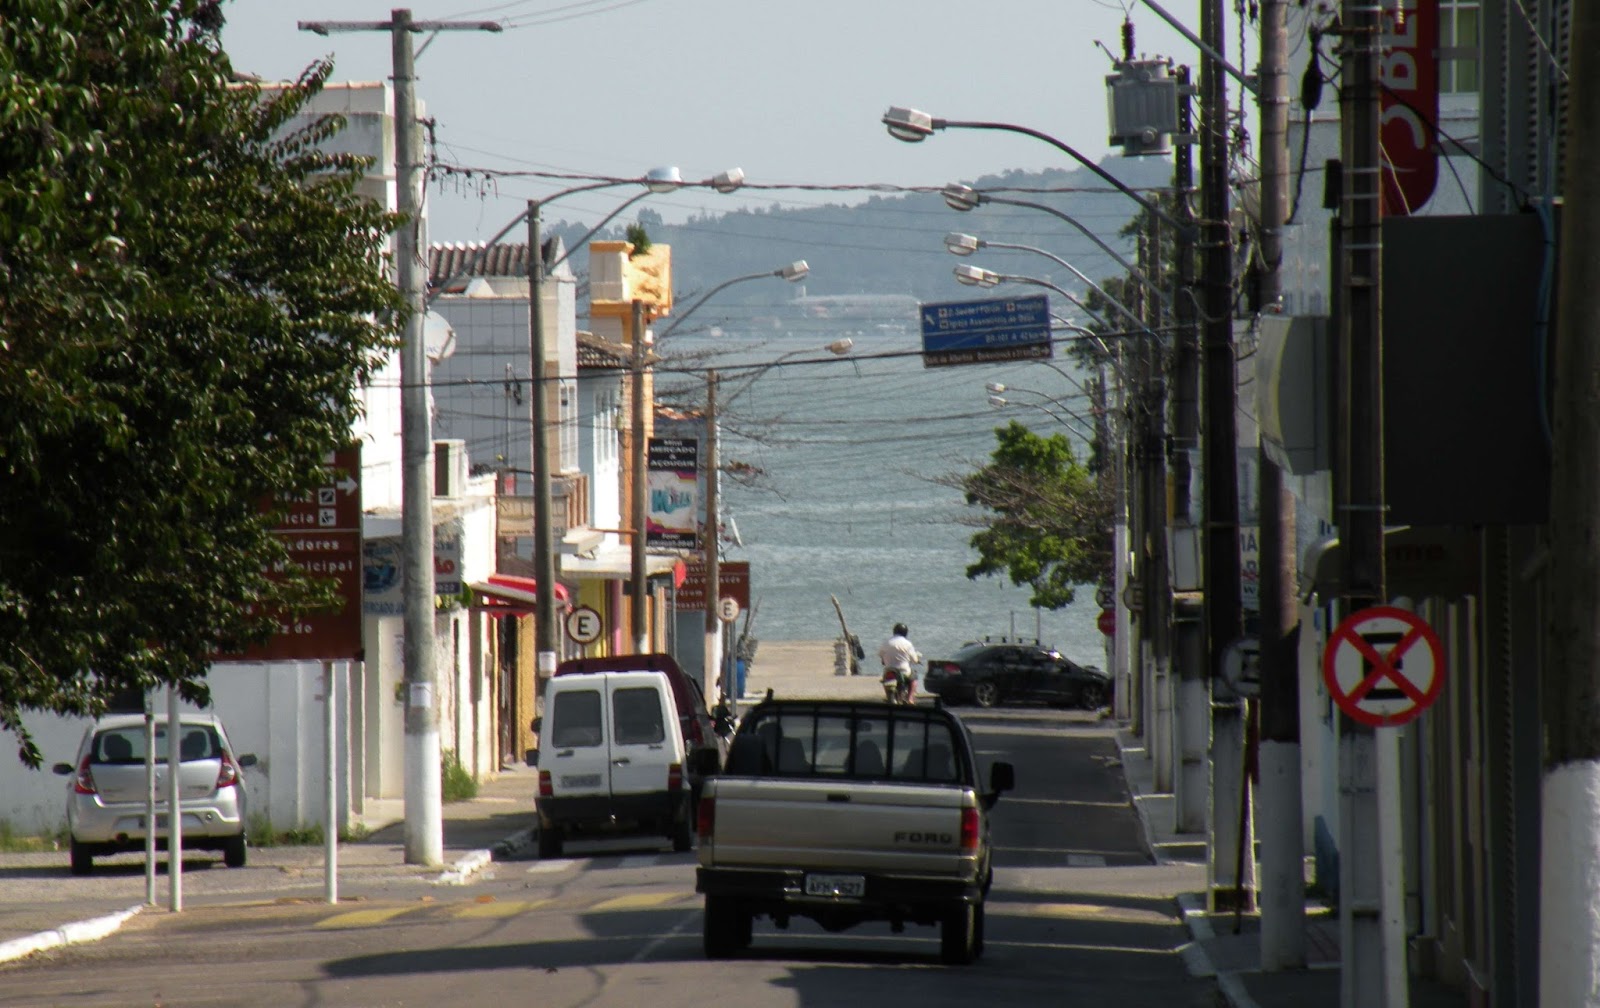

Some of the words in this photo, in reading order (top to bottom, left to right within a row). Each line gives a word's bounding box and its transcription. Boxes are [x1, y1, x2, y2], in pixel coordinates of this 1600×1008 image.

[650, 446, 697, 454] MERCADO
[274, 560, 353, 574] Mnicipal
[577, 616, 591, 636] E
[894, 831, 953, 844] FORD
